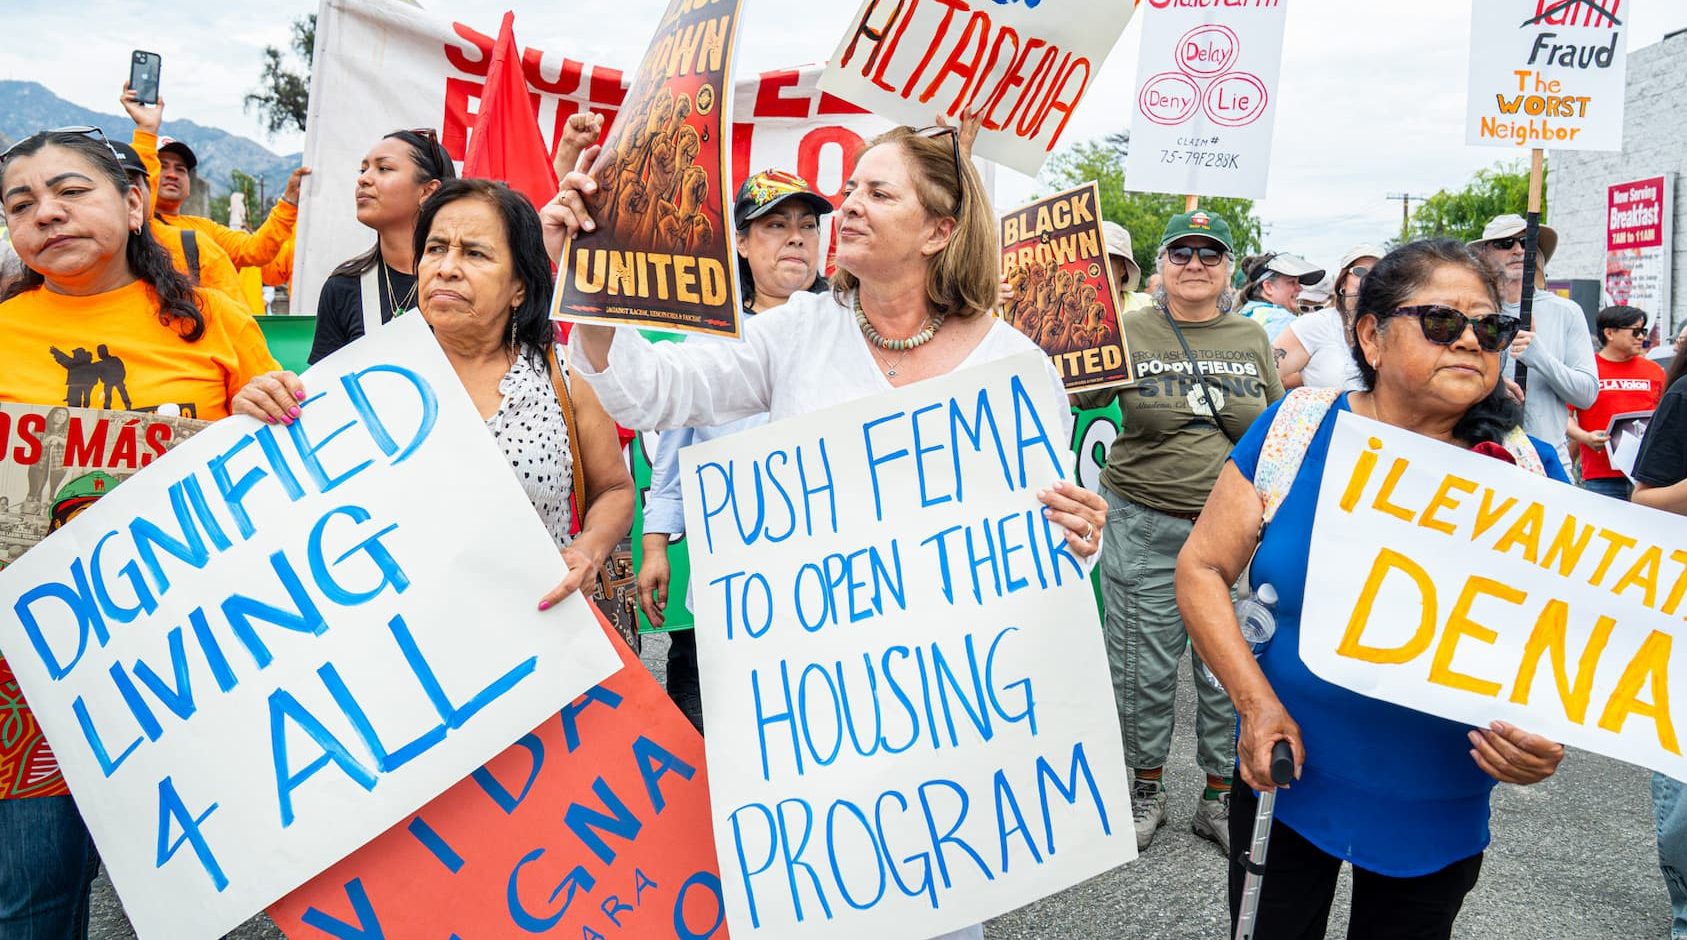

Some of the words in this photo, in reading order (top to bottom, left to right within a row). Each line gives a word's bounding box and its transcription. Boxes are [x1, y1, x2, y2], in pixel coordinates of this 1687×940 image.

[840, 0, 1091, 152] ALTADENA
[1186, 41, 1230, 65] Delay
[1527, 32, 1619, 69] Fraud
[1149, 90, 1191, 113] Deny
[1218, 87, 1249, 110] Lie
[1496, 94, 1591, 118] WORST
[1514, 70, 1561, 93] The
[1480, 117, 1580, 146] Neighbor
[1004, 192, 1094, 248] BLACK
[1610, 202, 1660, 230] Breakfast
[574, 248, 728, 307] UNITED
[1050, 344, 1123, 380] ITED
[1197, 361, 1258, 376] FIELDS
[63, 418, 172, 469] MÁS
[695, 437, 840, 555] PUSH
[862, 374, 1066, 522] FEMA
[13, 364, 439, 681] DIGNIFIED
[1339, 436, 1687, 621] ¡LEVANTAT
[709, 571, 774, 640] TO
[794, 538, 907, 633] OPEN
[920, 504, 1084, 607] THEIR
[72, 504, 411, 778] LIVING
[1335, 546, 1683, 757] DENA
[751, 627, 1038, 782] HOUSING
[155, 776, 230, 893] 4
[267, 613, 539, 829] ALL
[727, 741, 1112, 929] PROGRAM
